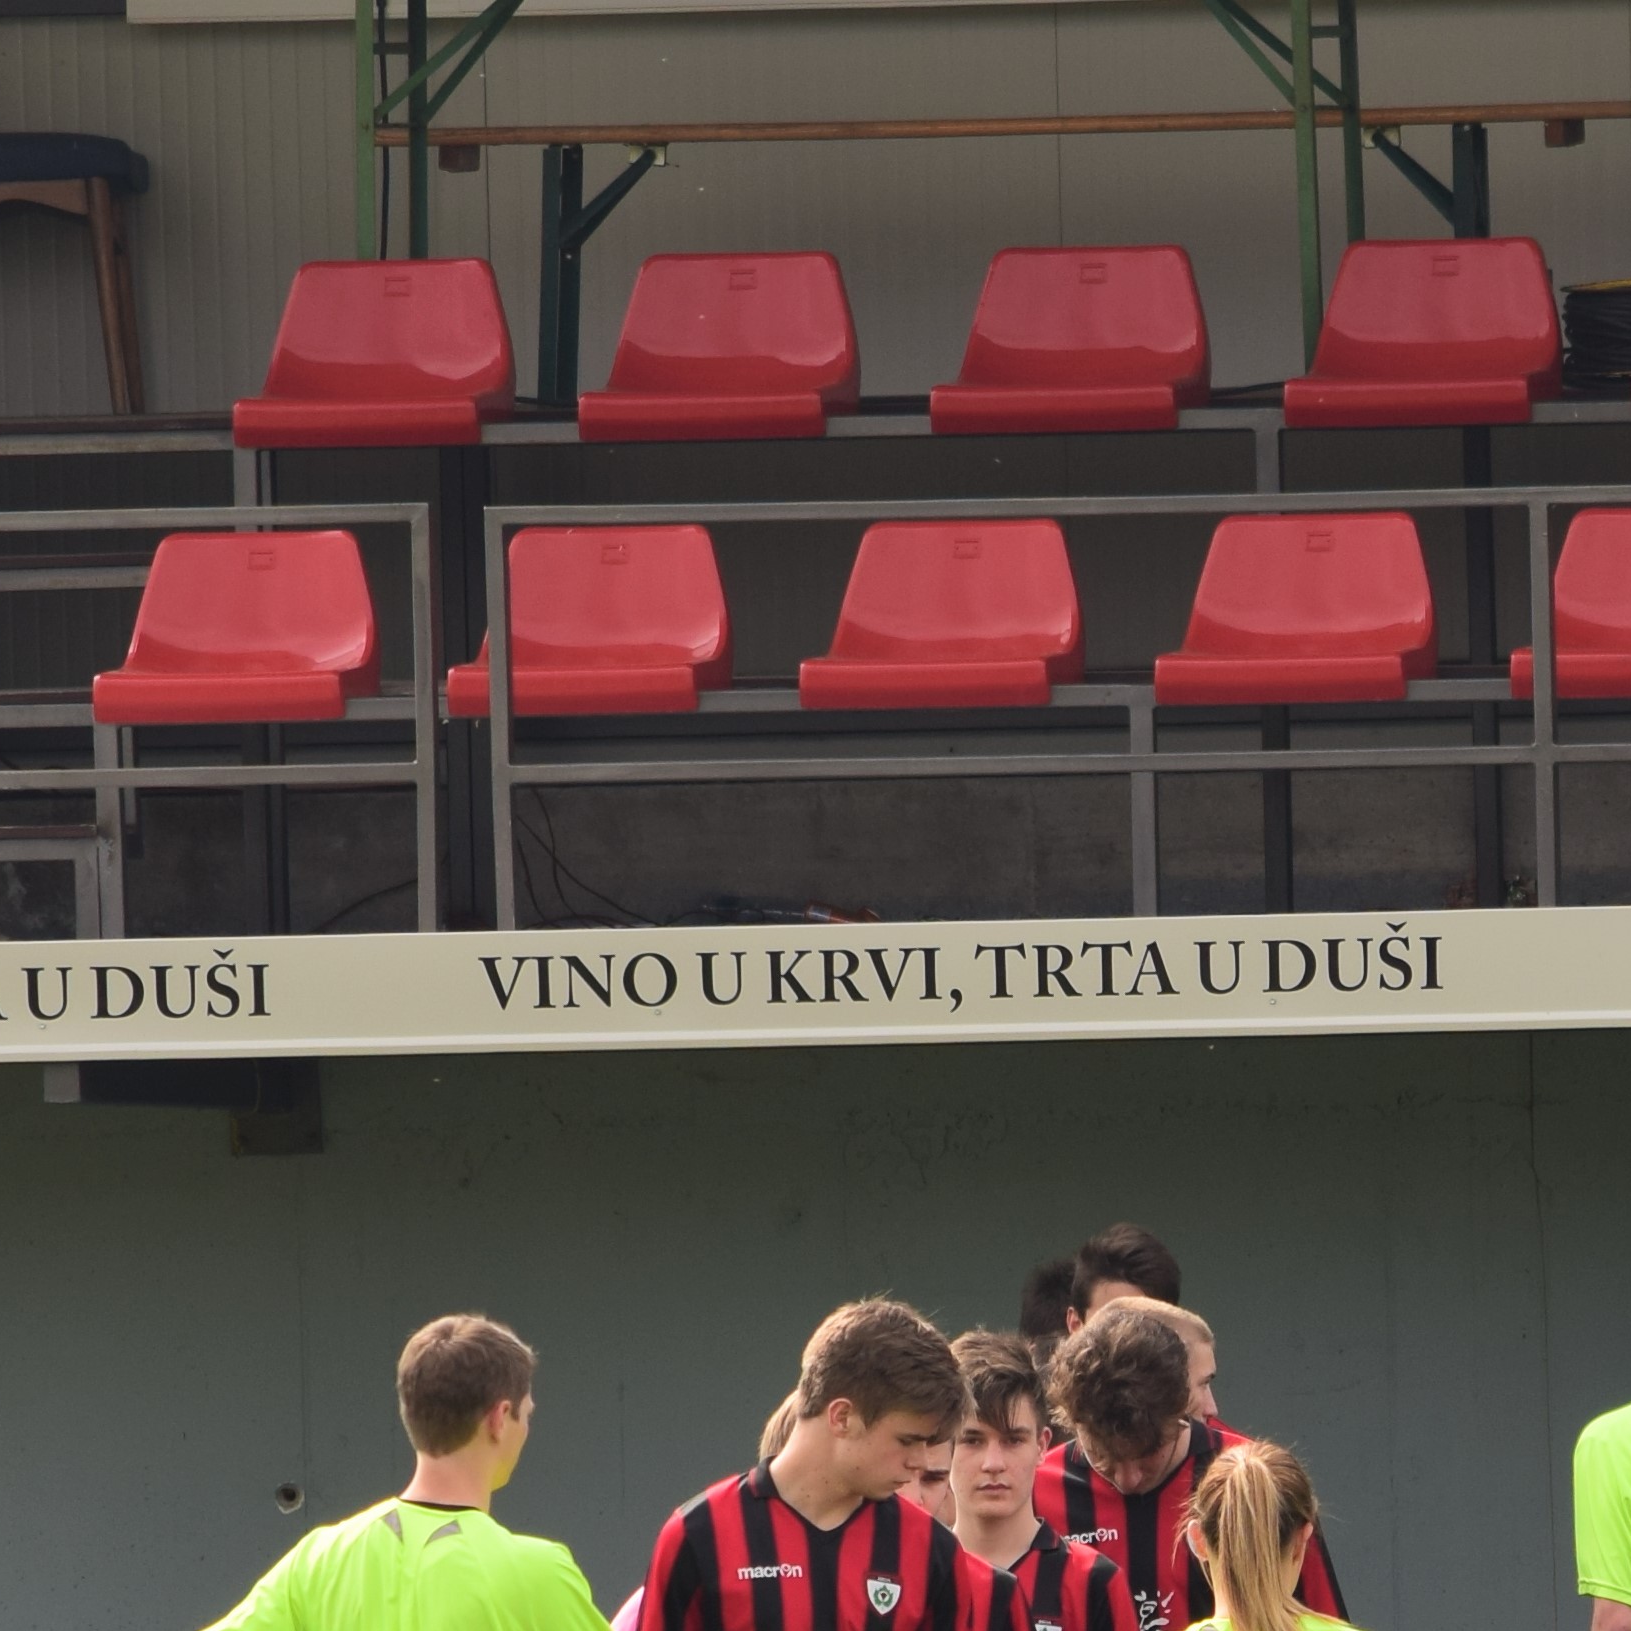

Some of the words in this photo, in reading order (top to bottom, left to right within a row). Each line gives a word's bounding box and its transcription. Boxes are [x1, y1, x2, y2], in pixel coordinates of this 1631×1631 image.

[21, 966, 73, 1021] U
[89, 948, 272, 1019] DUŠI
[477, 952, 678, 1011] VINO
[695, 951, 747, 1006] U
[765, 947, 963, 1012] KRVI,
[974, 940, 1181, 999] TRTA
[1193, 940, 1246, 995] U
[1261, 921, 1444, 993] DUŠI
[1062, 1527, 1118, 1546] acron
[737, 1563, 803, 1580] macron
